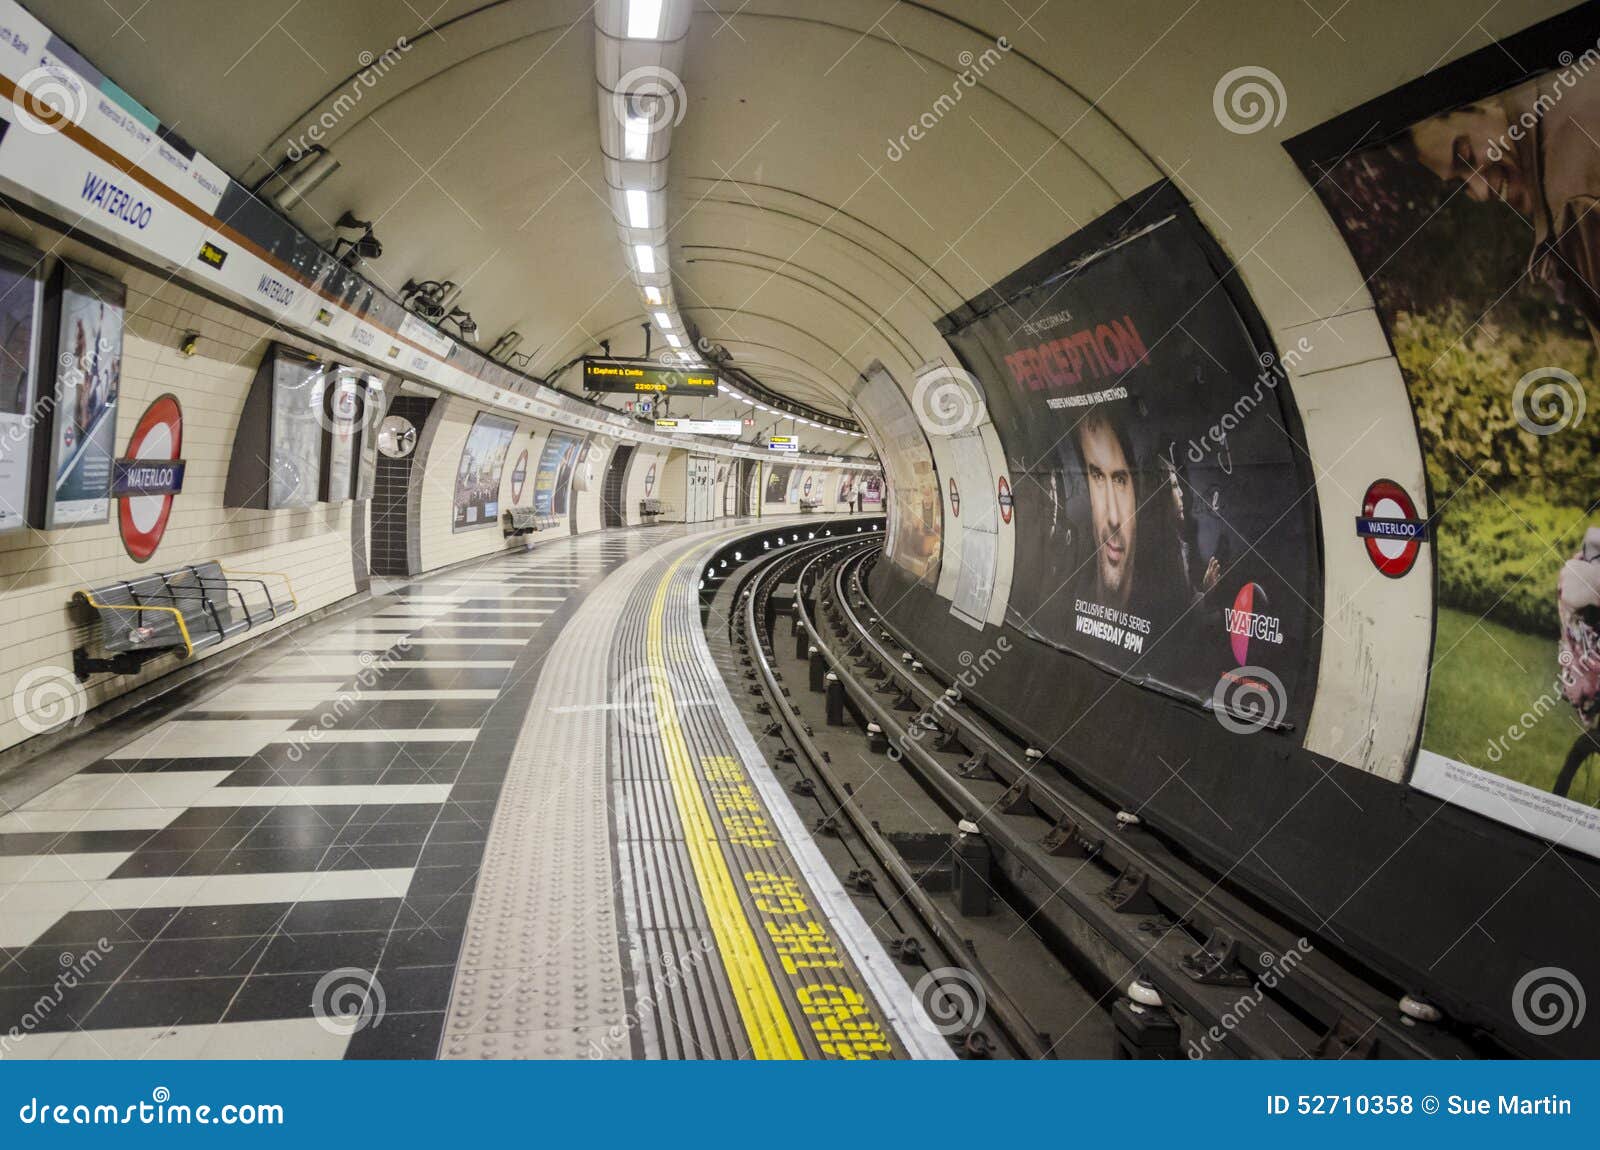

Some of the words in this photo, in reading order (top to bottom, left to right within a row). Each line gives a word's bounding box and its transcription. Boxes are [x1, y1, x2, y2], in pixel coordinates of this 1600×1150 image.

[81, 171, 152, 229] WATERLOO
[257, 273, 295, 307] WATERLOO
[1004, 314, 1150, 391] PERCEPTION
[127, 468, 174, 488] WATERLOO
[1368, 521, 1416, 537] WATERLOO
[1074, 599, 1105, 617] EXCLUSIVE
[1104, 607, 1120, 623] NEW
[1119, 610, 1129, 627] US
[1128, 615, 1151, 635] SERIES
[1225, 608, 1280, 643] WATCH
[1075, 615, 1125, 646] WEDNESDAY
[1123, 630, 1144, 655] 9PM
